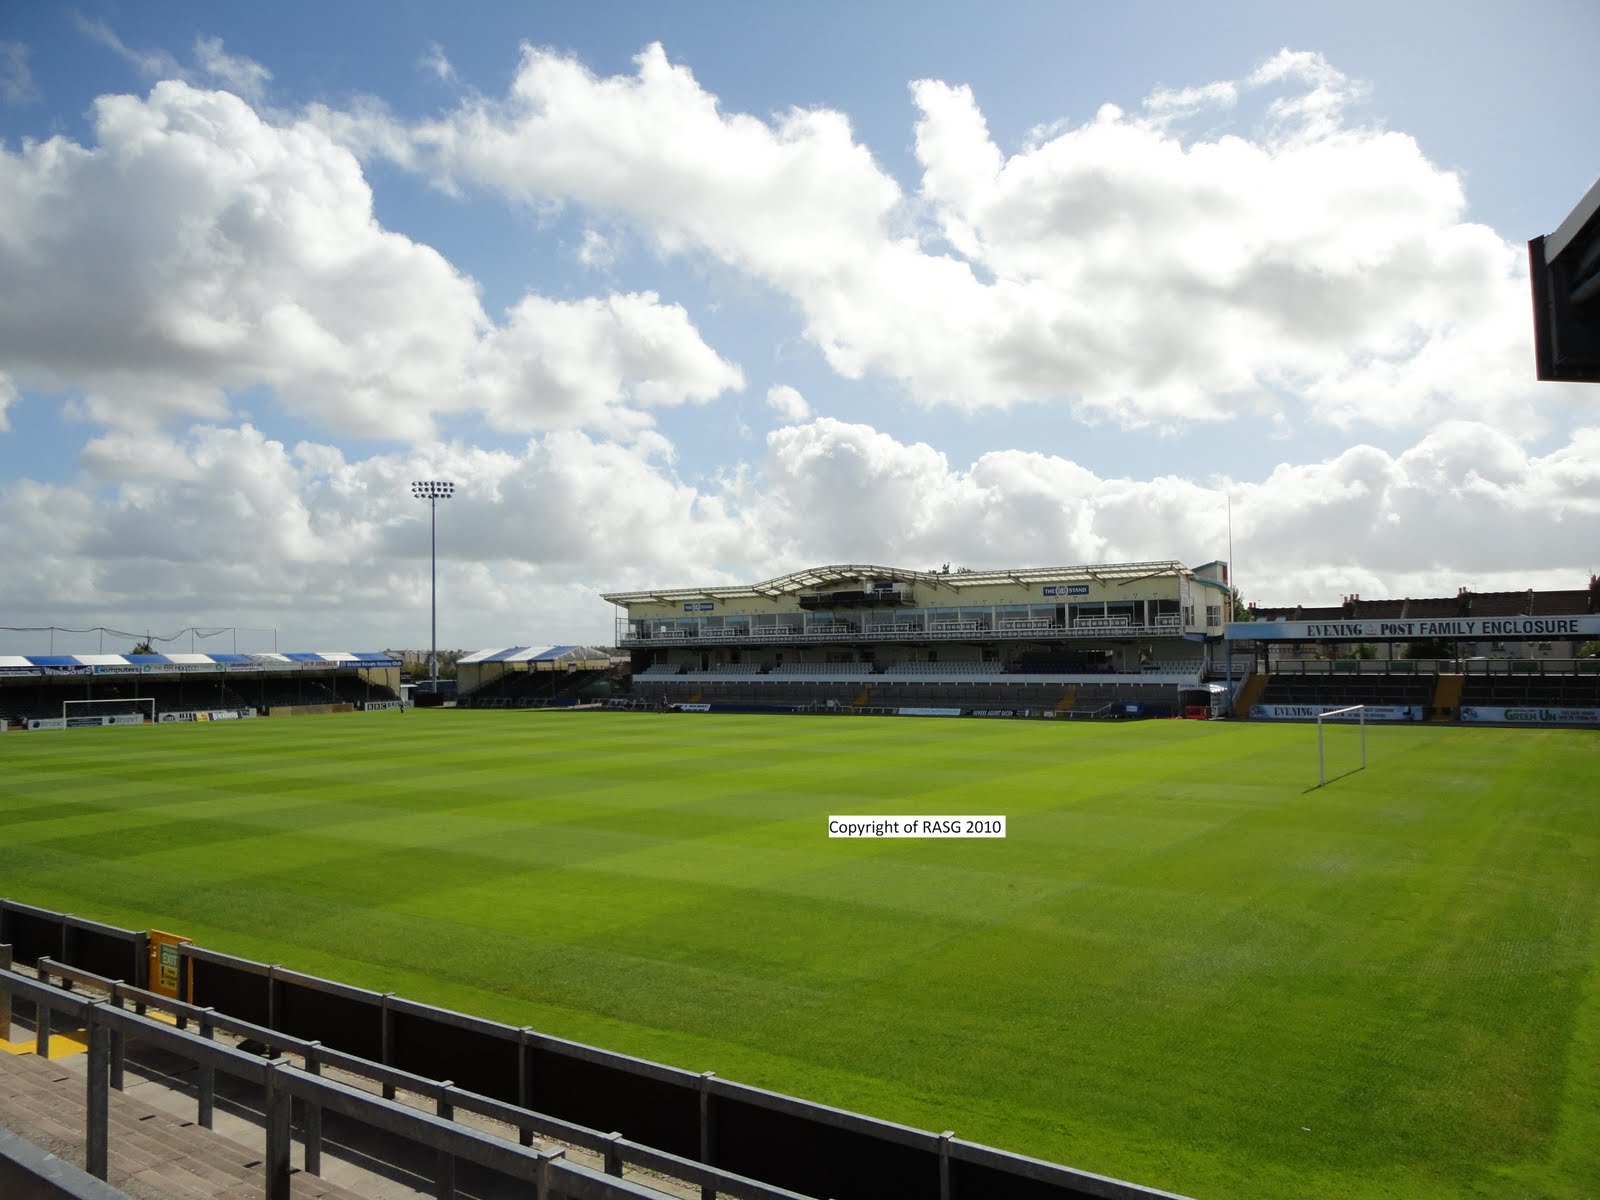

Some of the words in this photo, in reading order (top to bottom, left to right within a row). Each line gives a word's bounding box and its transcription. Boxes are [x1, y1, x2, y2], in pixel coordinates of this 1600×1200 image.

[1307, 624, 1362, 637] EVENING
[1380, 623, 1414, 636] POST
[1420, 621, 1475, 635] FAMILY
[1482, 619, 1578, 634] ENCLOSURE
[45, 666, 92, 675] WINDOWS
[1274, 707, 1312, 717] EVENING
